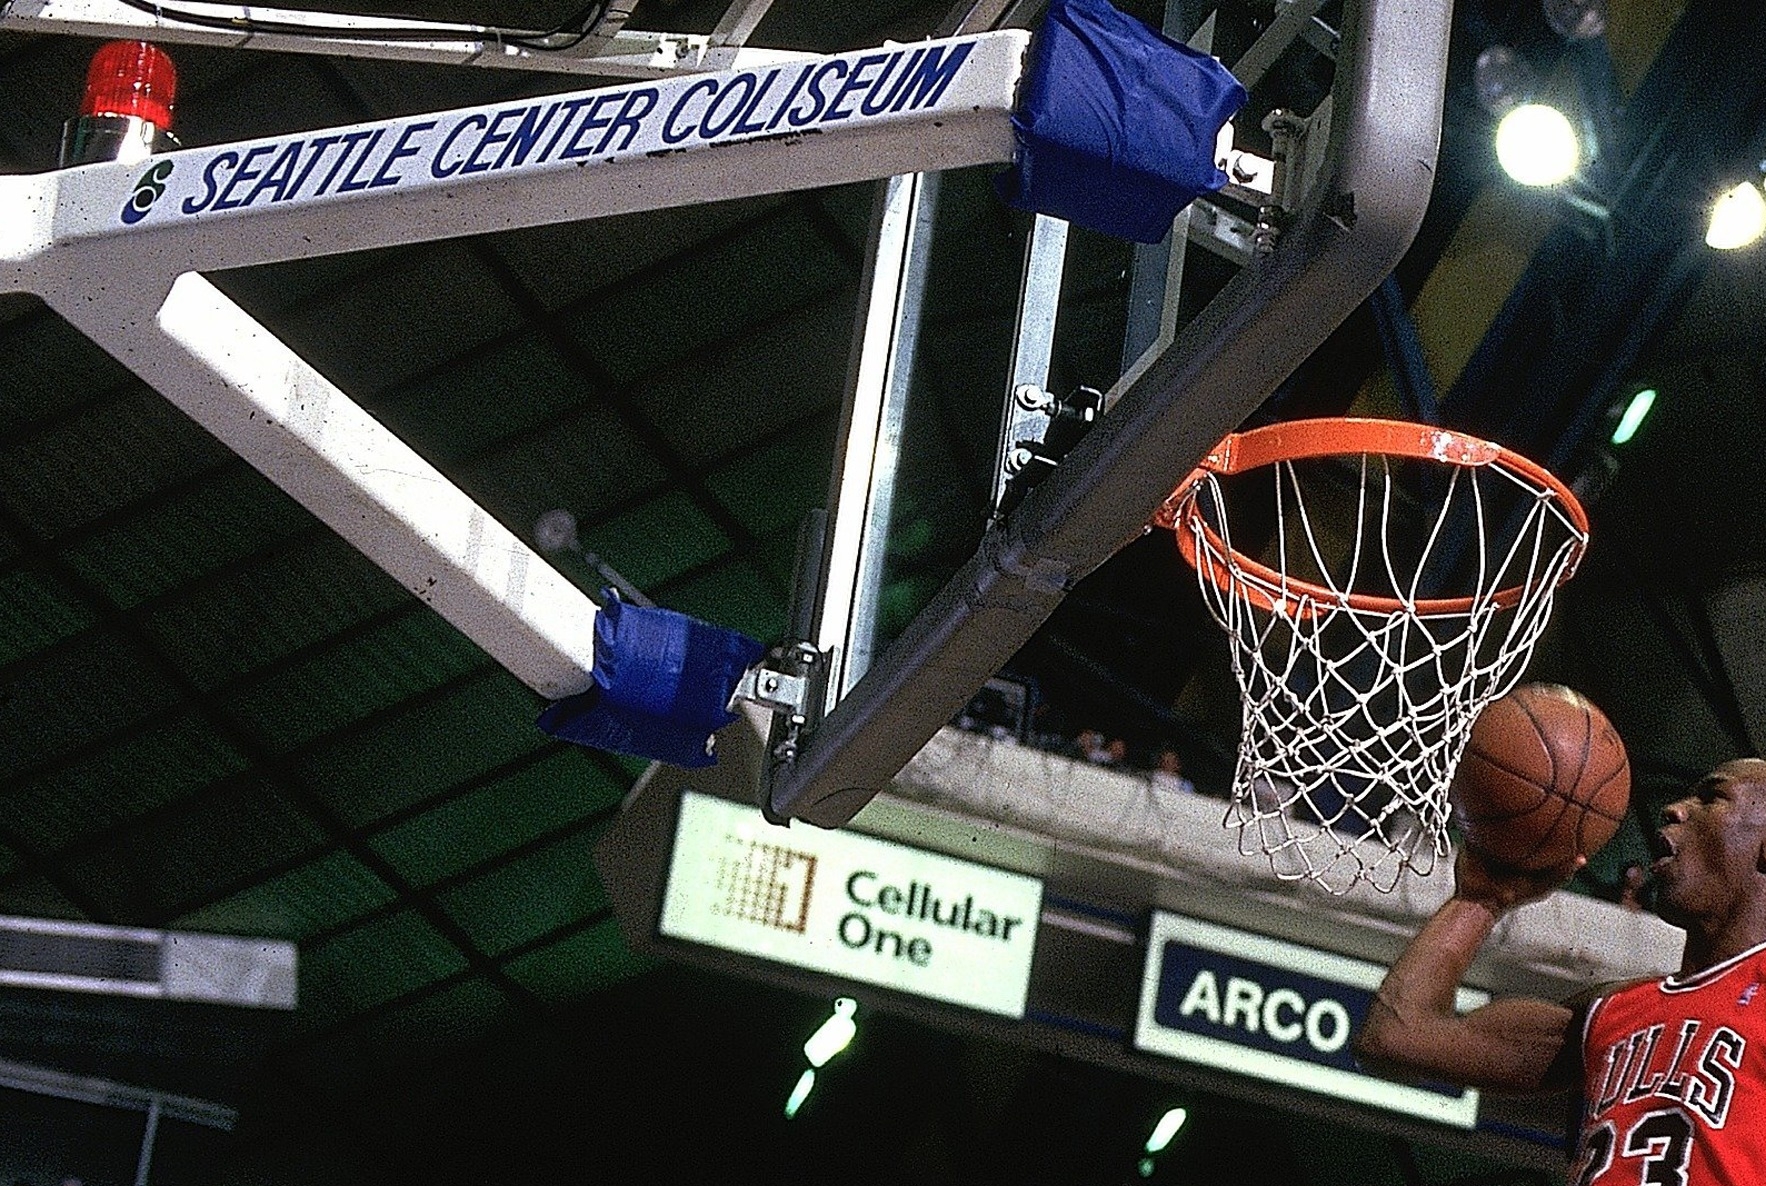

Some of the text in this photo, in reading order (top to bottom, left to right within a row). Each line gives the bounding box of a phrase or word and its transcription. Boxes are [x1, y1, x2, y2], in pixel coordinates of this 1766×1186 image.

[181, 42, 977, 216] SEATTLE CENTER COLISEUM
[838, 912, 933, 967] One
[845, 869, 1023, 942] Cellular
[1178, 969, 1351, 1053] ARCO
[1588, 1019, 1747, 1130] ULLS
